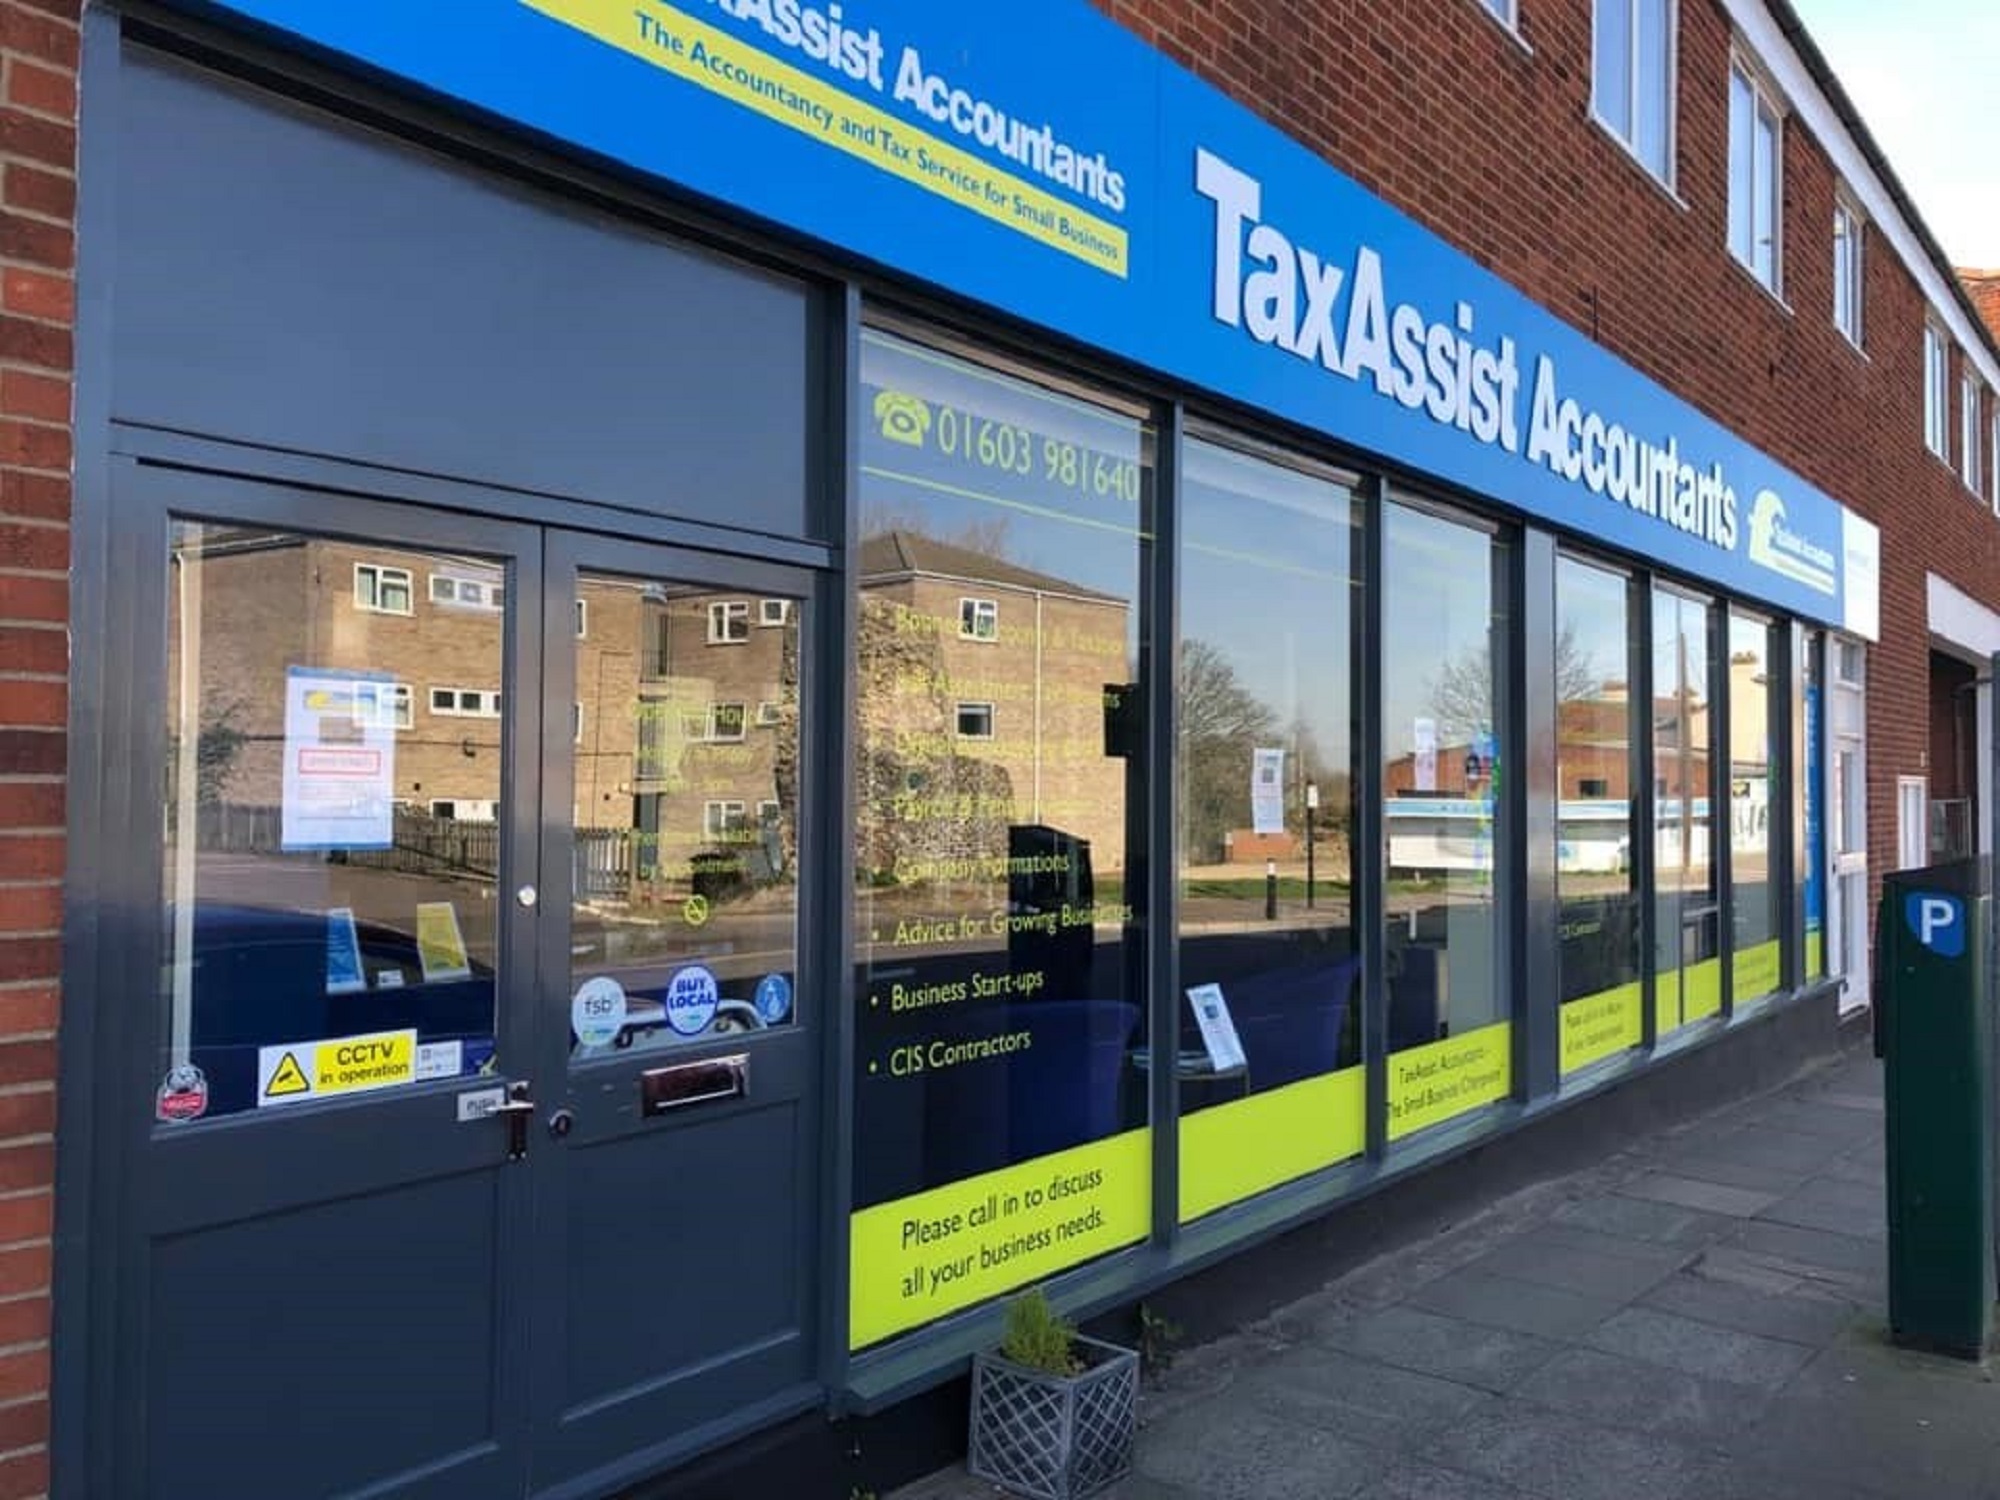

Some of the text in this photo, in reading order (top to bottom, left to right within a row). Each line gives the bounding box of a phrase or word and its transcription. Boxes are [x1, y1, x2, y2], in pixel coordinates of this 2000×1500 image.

[634, 10, 1119, 260] The Accountancy and Tax Service for Small Business
[893, 46, 1126, 213] Accountants
[1196, 146, 1738, 550] TaxAssist Accountants
[938, 407, 1141, 501] 01603 981640
[894, 918, 955, 946] Advice
[959, 914, 984, 940] for
[990, 908, 1057, 934] Growing
[1921, 899, 1953, 944] P
[668, 990, 714, 1010] LOCAL
[676, 977, 706, 994] BUY
[891, 970, 1044, 1012] Business Start-ups
[320, 1063, 409, 1085] in operation
[336, 1041, 395, 1066] CCTV
[890, 1032, 1031, 1076] CIS Contractors
[903, 1168, 1103, 1250] Please call in to discuss
[902, 1266, 924, 1298] all
[930, 1255, 974, 1296] your
[980, 1227, 1051, 1269] business
